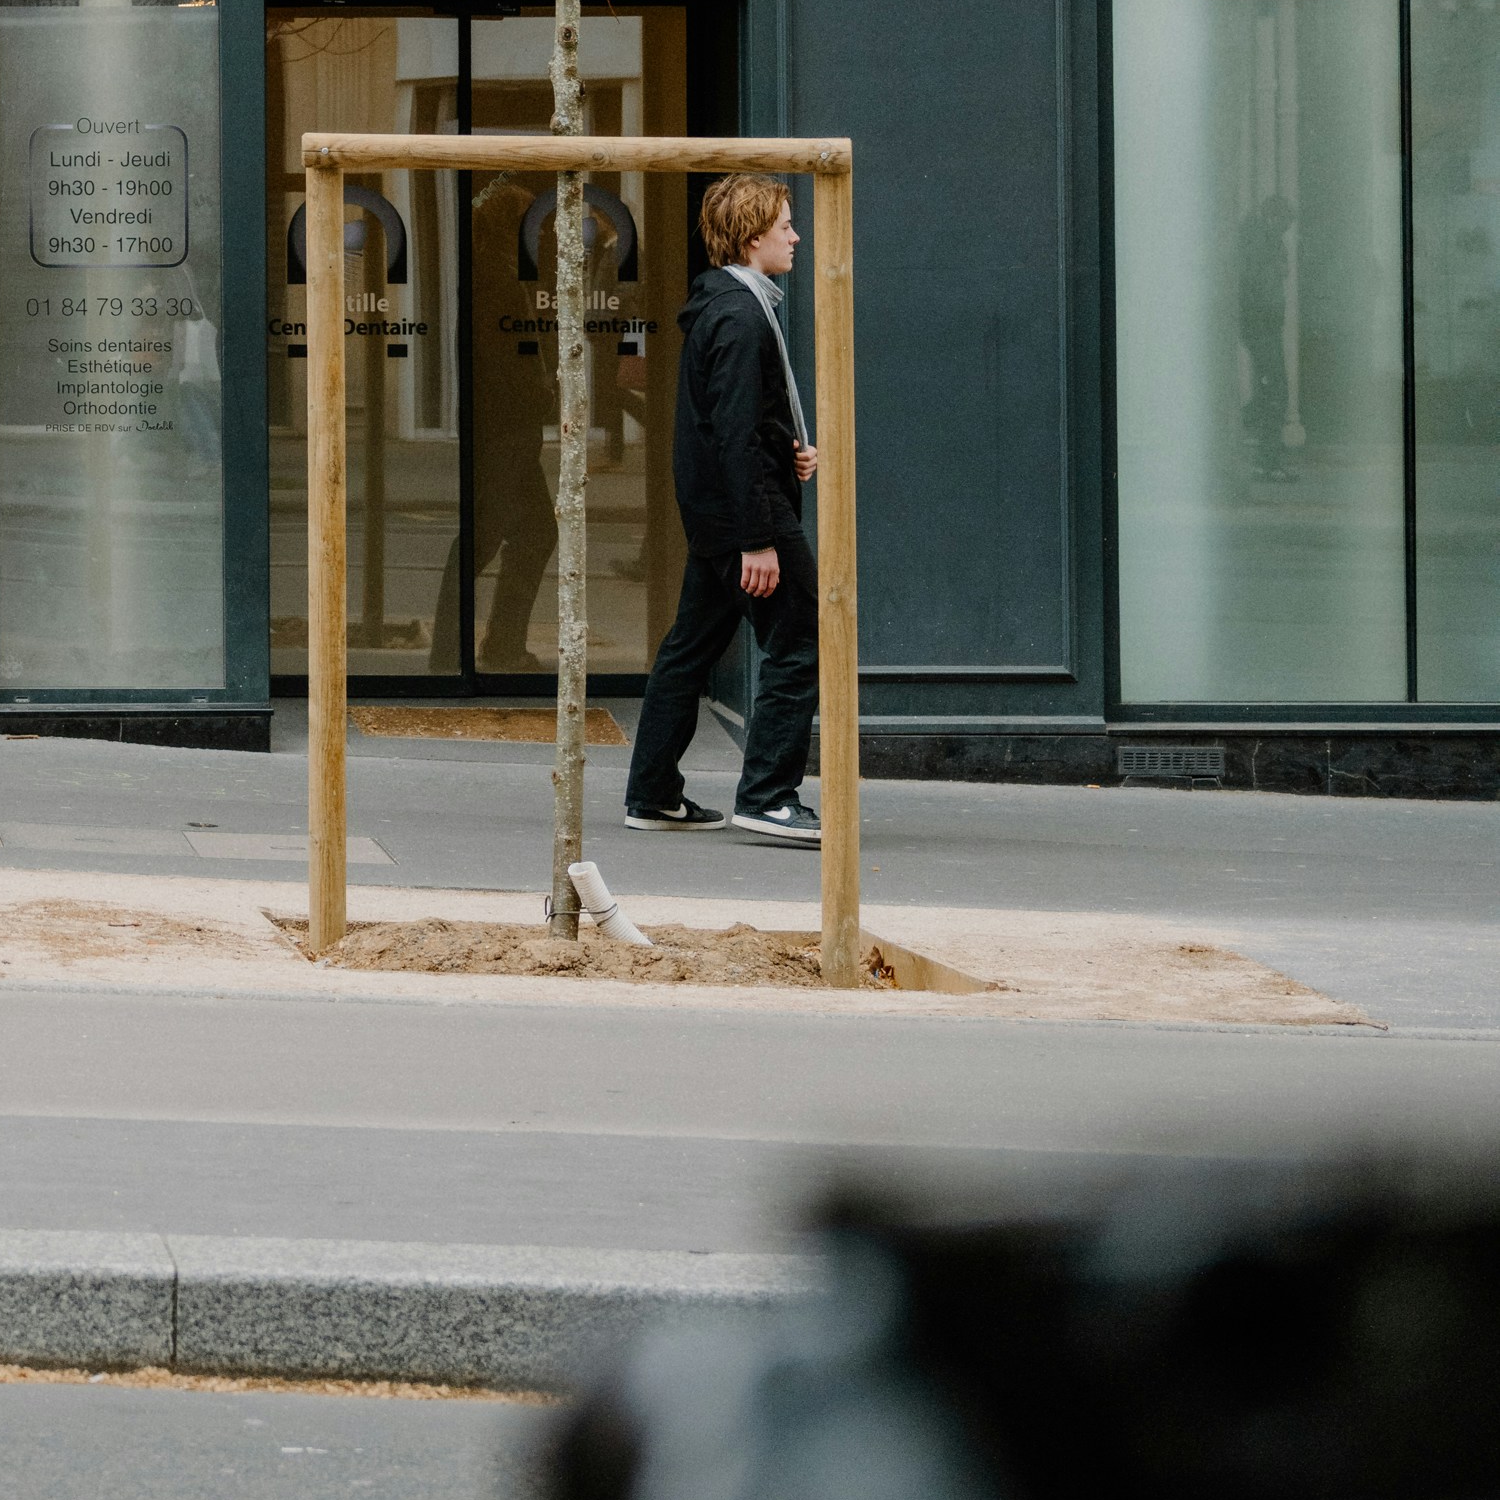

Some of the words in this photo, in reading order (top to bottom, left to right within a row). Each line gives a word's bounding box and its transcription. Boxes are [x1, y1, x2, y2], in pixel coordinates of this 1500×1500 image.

[76, 117, 140, 134] Ouvert
[50, 151, 101, 167] Lundi
[120, 151, 171, 167] Jeudi
[48, 180, 95, 196] 9h30
[116, 180, 172, 196] 19h00
[70, 208, 152, 224] Vendredi
[48, 237, 95, 253] 9h30
[116, 237, 173, 253] 17h00
[26, 298, 51, 316] 01
[61, 298, 87, 316] 84
[96, 298, 123, 316] 79
[131, 298, 158, 316] 33
[165, 298, 193, 316] 30
[345, 293, 389, 312] tille
[536, 291, 620, 310] Baille
[268, 318, 307, 336] Cen
[584, 316, 658, 334] entaire
[48, 338, 93, 353] Soins
[97, 338, 172, 353] dentaires
[67, 359, 152, 376] Esthétique
[57, 381, 164, 397] Implantologie
[63, 401, 157, 415] Orthodontie
[45, 423, 75, 432] PRISE
[78, 423, 91, 432] DE
[94, 423, 115, 432] RDV
